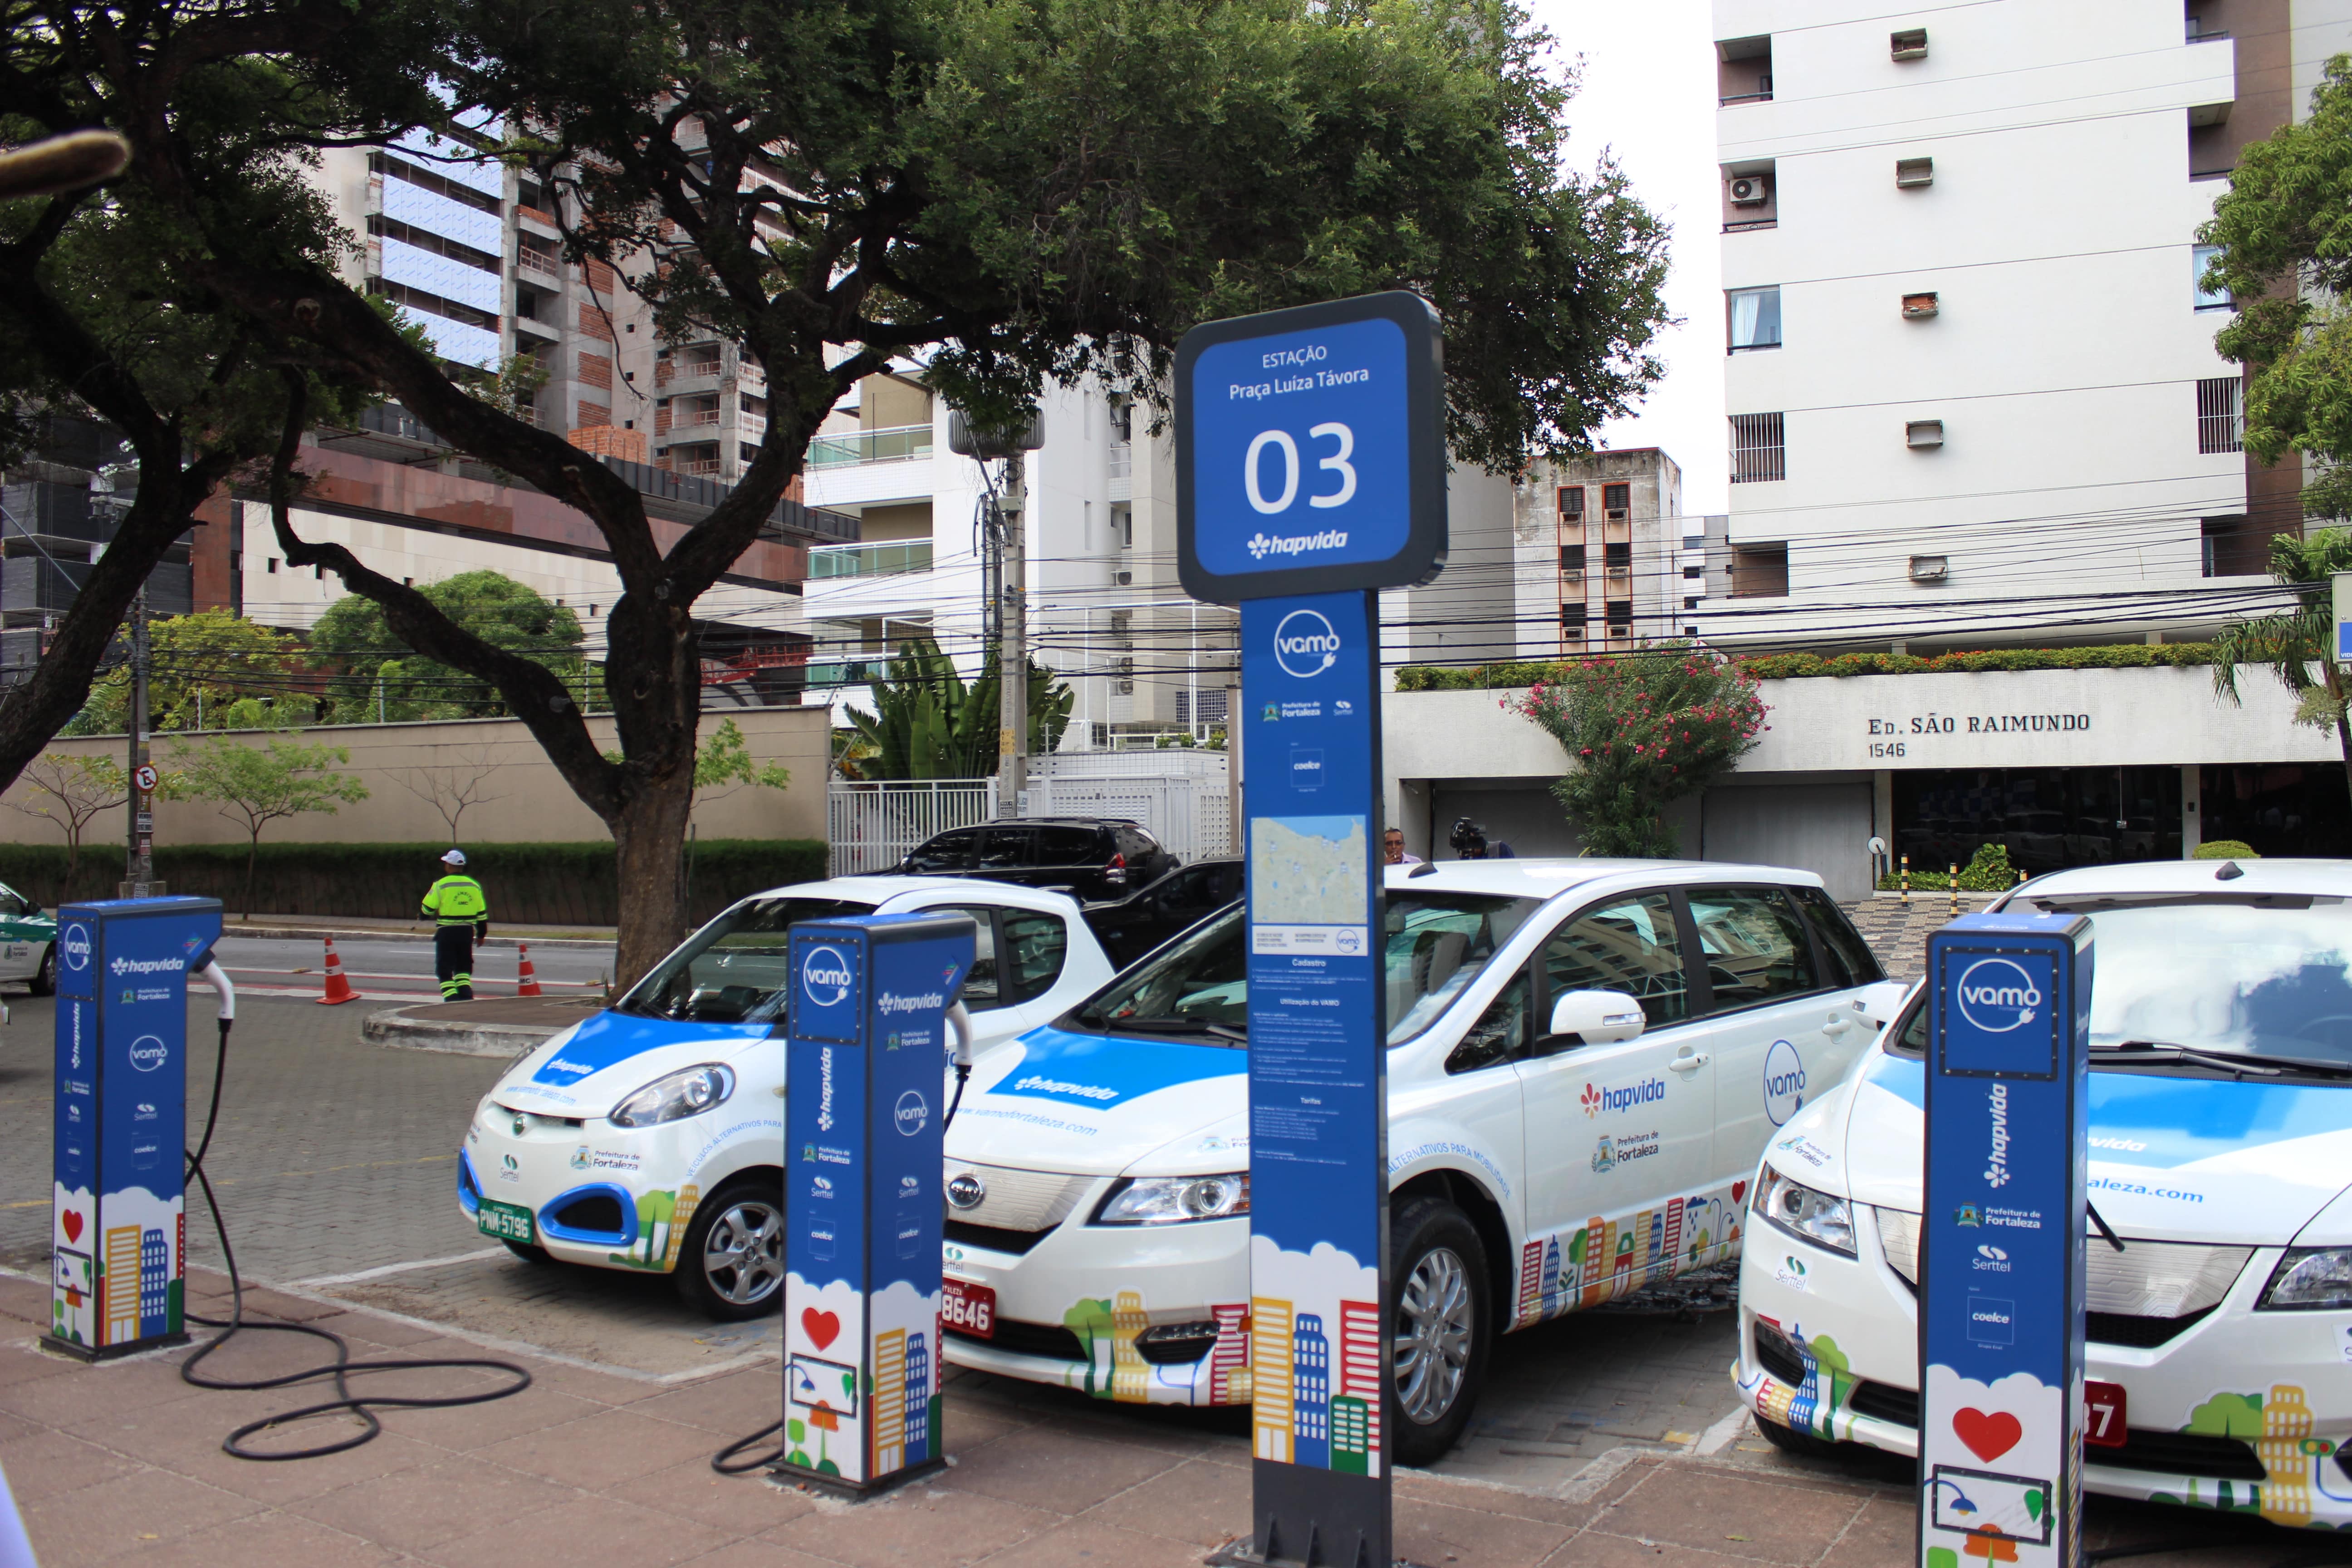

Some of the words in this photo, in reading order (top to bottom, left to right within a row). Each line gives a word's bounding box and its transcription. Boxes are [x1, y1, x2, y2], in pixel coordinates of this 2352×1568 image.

[1263, 345, 1327, 368] ESTAÇÃO
[1230, 382, 1271, 401] Praça
[1274, 374, 1313, 394] Luíza
[1316, 368, 1369, 387] Távora
[1245, 421, 1357, 514] 03
[1270, 529, 1348, 555] hapvida
[1279, 634, 1340, 654] vamo
[1282, 709, 1320, 717] Fortaleza
[1911, 713, 1955, 734] SÃO
[1968, 714, 2090, 733] RAIMUNDO
[1869, 743, 1905, 758] 1546
[1294, 761, 1320, 770] coelce
[142, 770, 152, 786] E
[66, 941, 90, 954] vamo
[128, 957, 184, 974] hapvida
[1293, 959, 1326, 967] Cadastro
[807, 969, 850, 986] vamo
[893, 993, 943, 1014] hapvida
[1963, 986, 2041, 1006] vamo
[901, 1037, 929, 1046] Fortaleza
[132, 1048, 167, 1059] vamo
[820, 1047, 833, 1112] hapvida
[1766, 1070, 1805, 1098] vamo
[1603, 1078, 1664, 1113] hapvida
[897, 1106, 927, 1121] vamo
[945, 1107, 1098, 1136] ww.vamofortaleza.com
[1988, 1083, 2011, 1165] hapvida
[712, 1120, 762, 1146] ALTERNATIVOS
[763, 1120, 782, 1128] PARA
[1618, 1134, 1649, 1147] Prefeitura
[1651, 1130, 1659, 1139] de
[134, 1145, 157, 1153] coelce
[595, 1150, 628, 1159] Prefeitura
[818, 1147, 842, 1155] Prefeitura
[1617, 1144, 1659, 1163] Fortaleza
[1793, 1146, 1823, 1167] Fortaleza
[593, 1158, 638, 1171] Fortaleza
[818, 1153, 850, 1165] Fortaleza
[500, 1167, 519, 1182] Serttel
[1387, 1142, 1449, 1176] ALTERNATIVOS
[1450, 1143, 1473, 1158] PARA
[1473, 1150, 1510, 1200] MOBILIDADE
[811, 1187, 833, 1199] Serttel
[899, 1186, 918, 1198] Serttel
[1985, 1207, 2028, 1217] Prefeitura
[2030, 1210, 2041, 1219] de
[1985, 1215, 2041, 1229] Fortaleza
[811, 1230, 833, 1240] coelce
[899, 1228, 918, 1239] coelce
[942, 1259, 962, 1274] erttel
[1972, 1258, 2010, 1272] Serttel
[1775, 1269, 1806, 1290] Serttel
[1972, 1312, 2009, 1324] coelce
